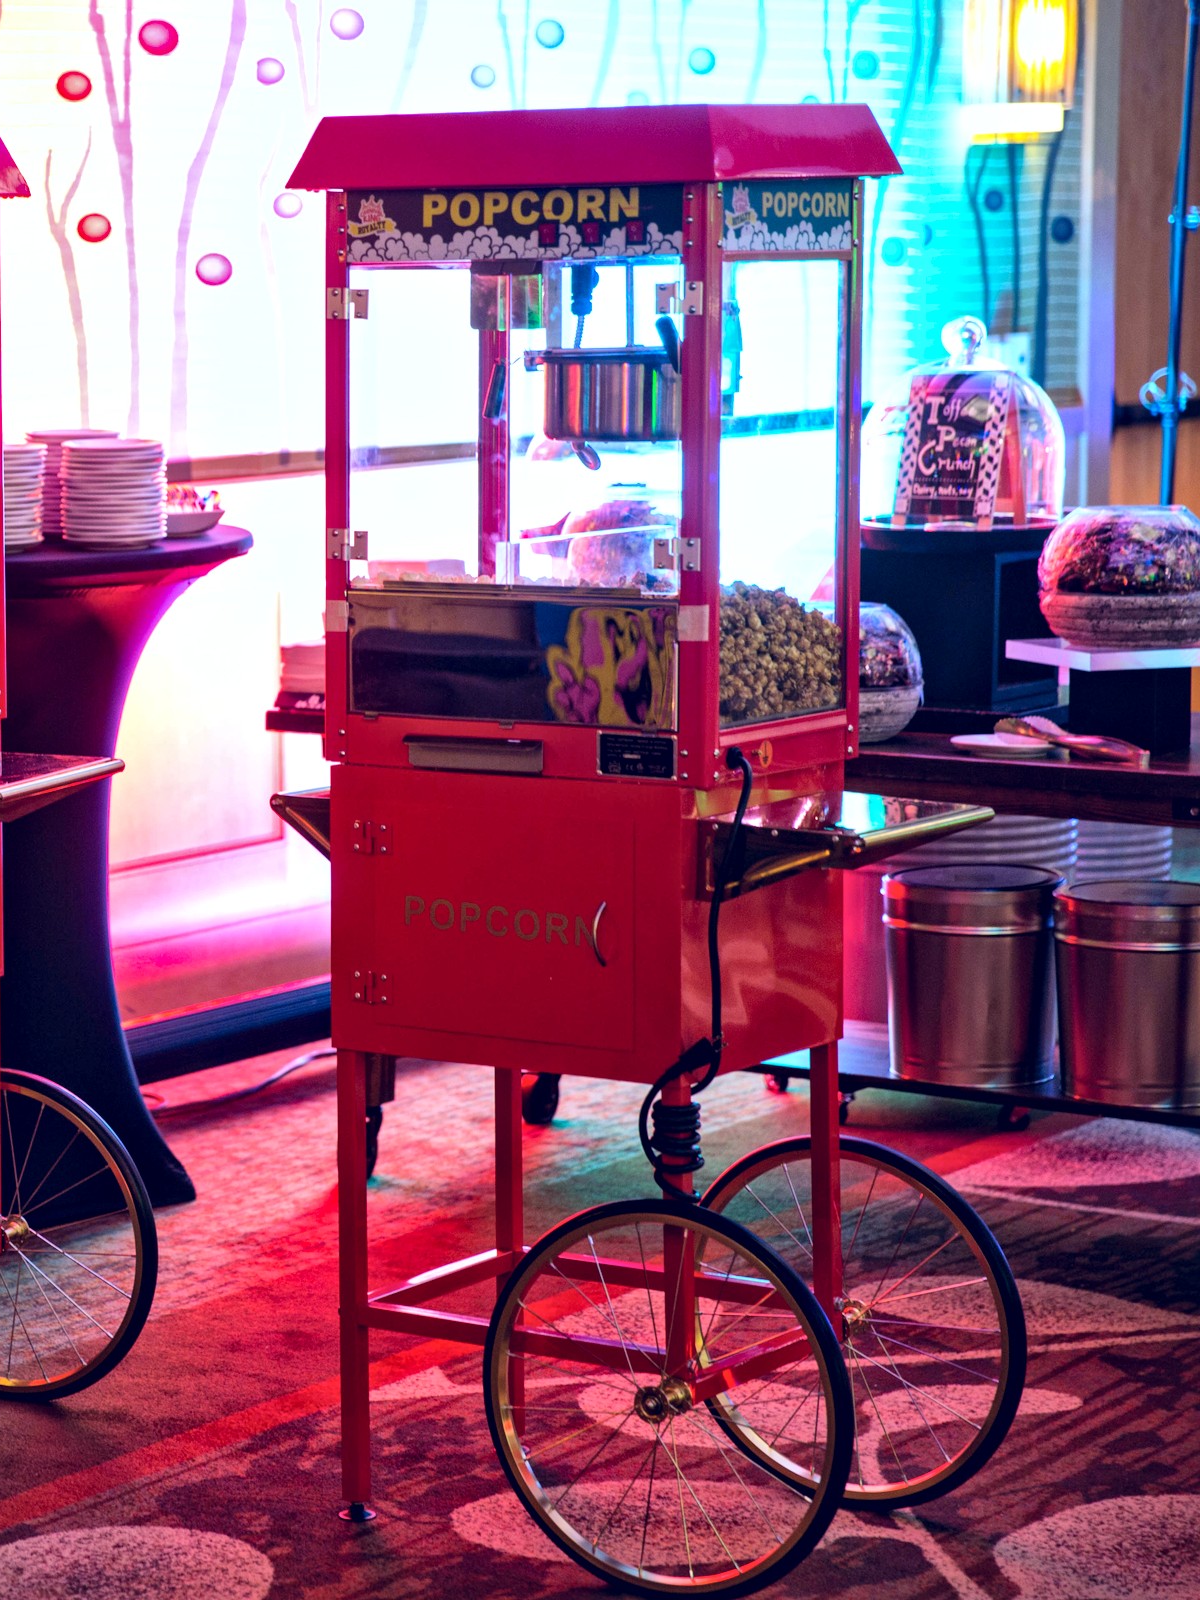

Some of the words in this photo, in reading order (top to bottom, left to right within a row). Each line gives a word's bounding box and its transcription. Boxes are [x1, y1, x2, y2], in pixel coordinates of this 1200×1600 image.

[422, 187, 640, 228] POPCORN
[761, 191, 850, 218] POPCORN
[925, 396, 972, 425] Toff
[934, 425, 977, 452] Pecan
[917, 440, 976, 479] Crunch
[404, 895, 598, 947] POPCORN
